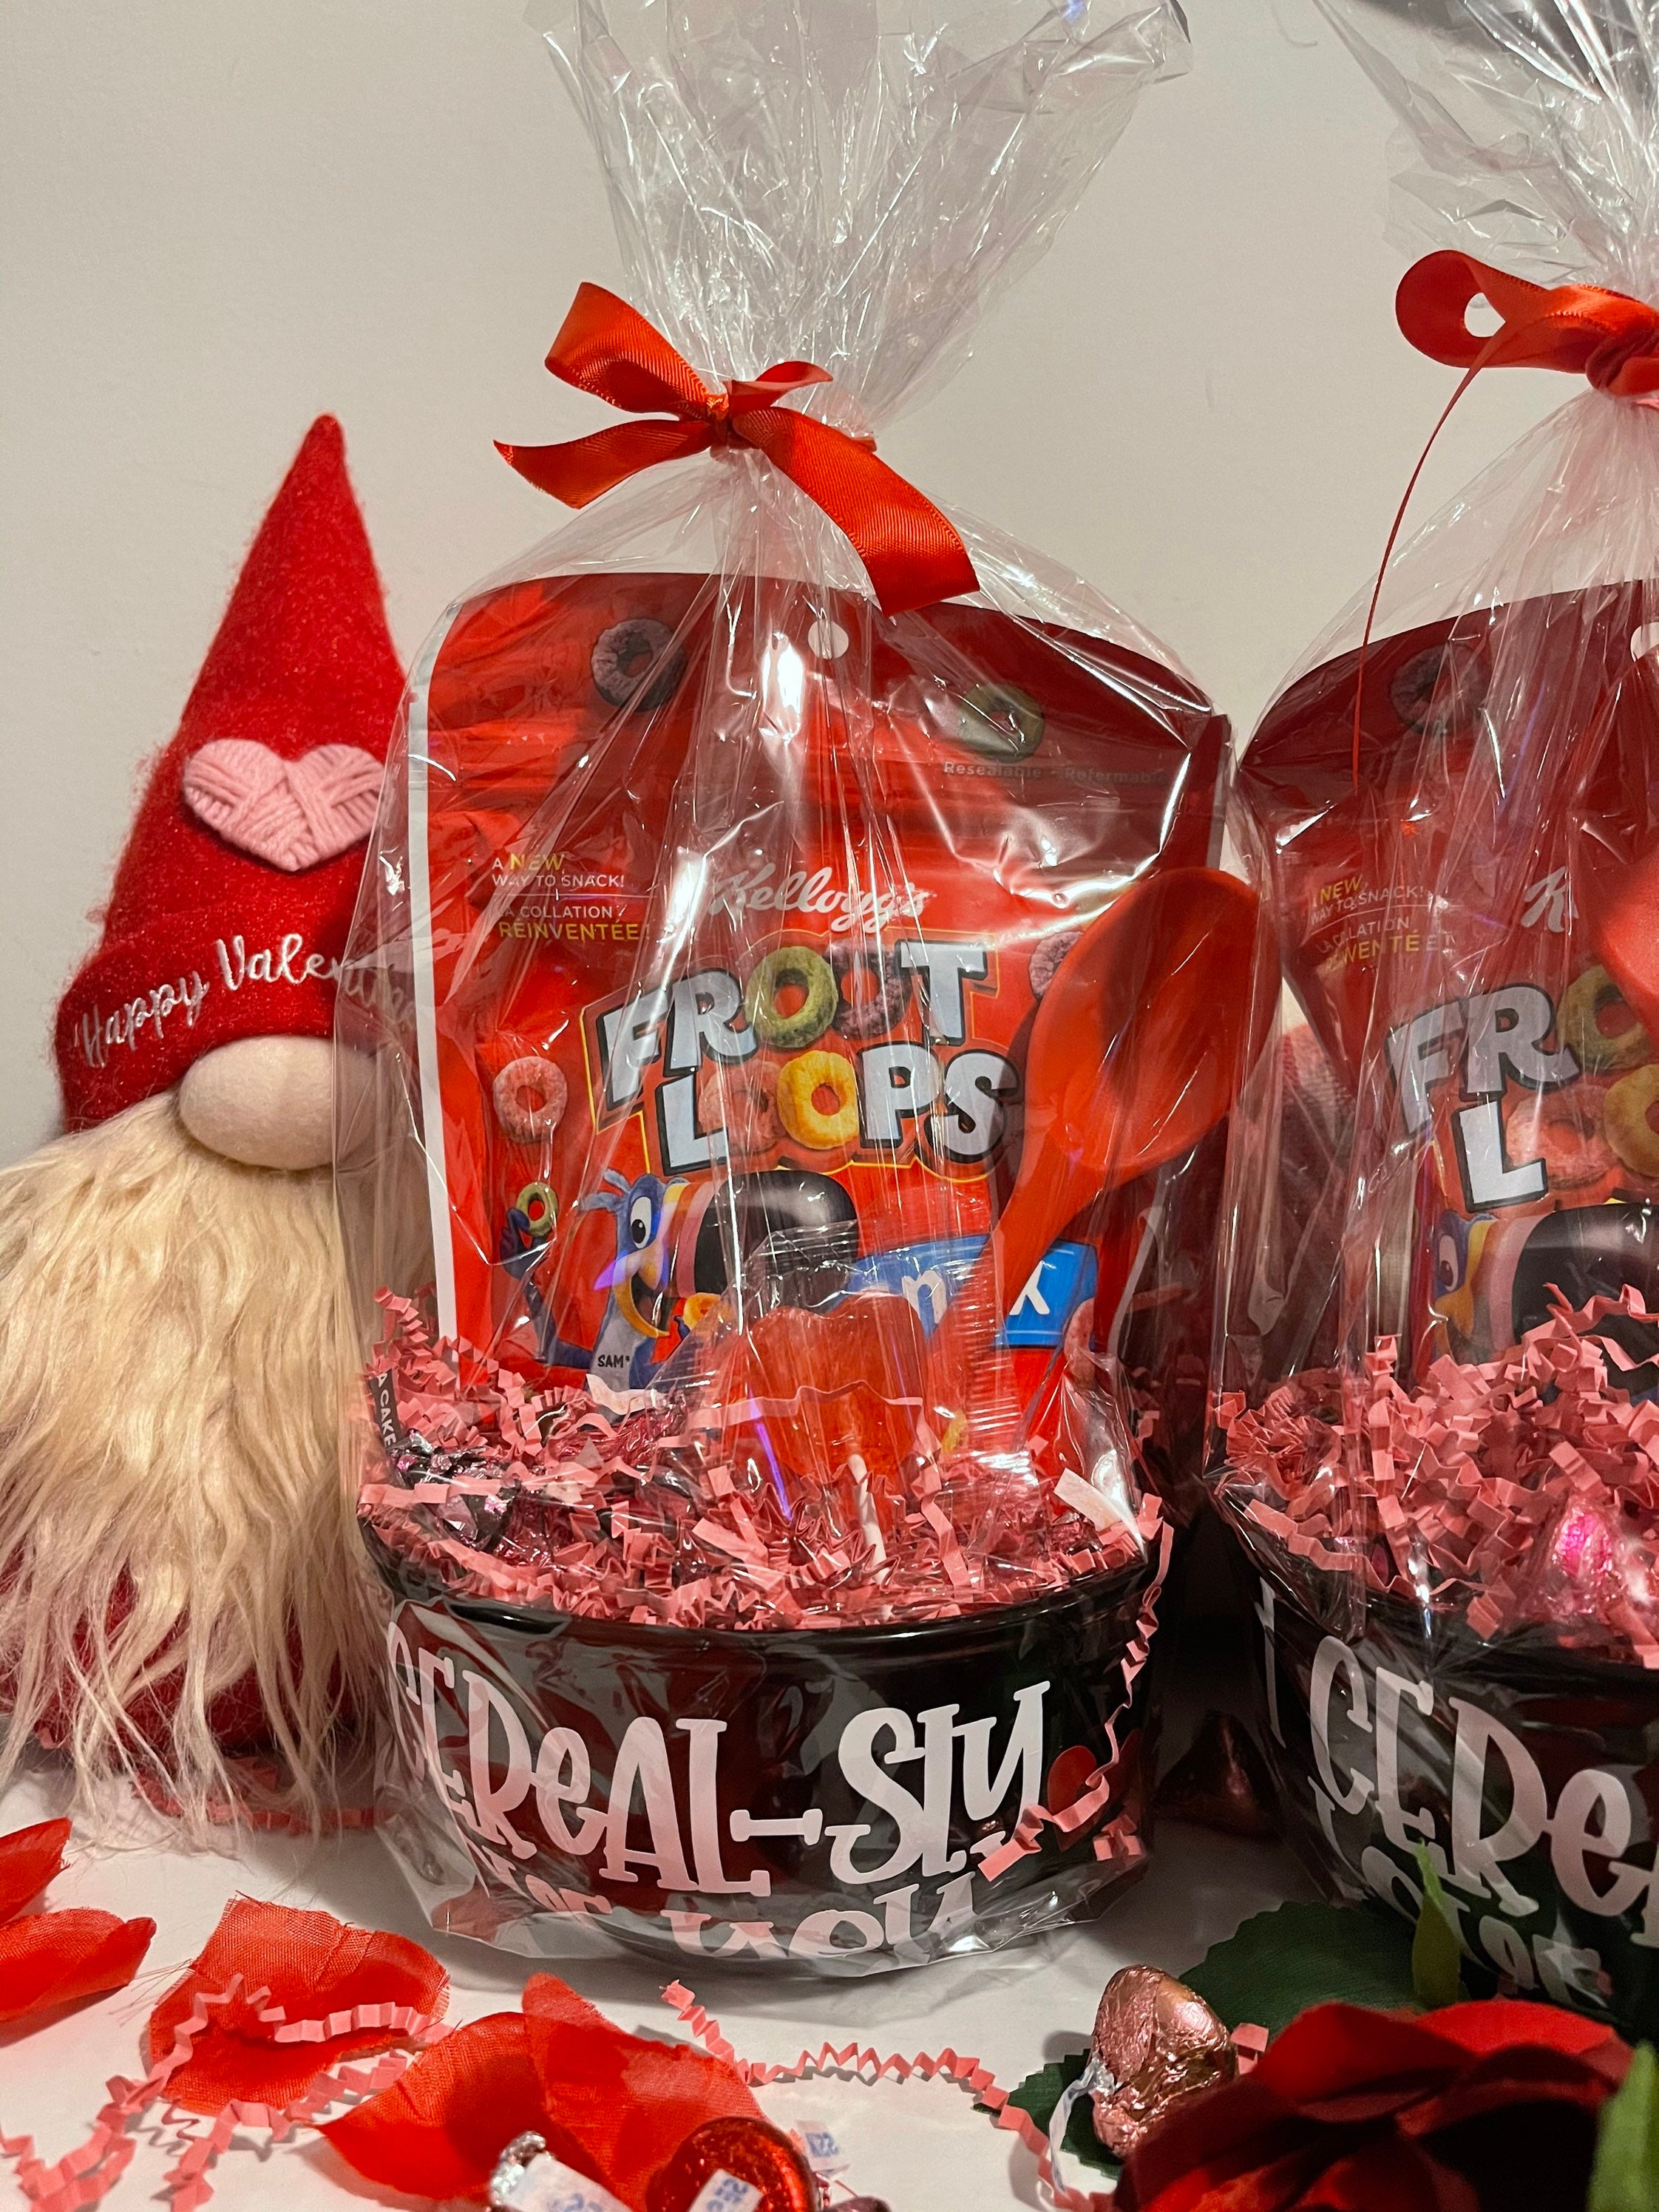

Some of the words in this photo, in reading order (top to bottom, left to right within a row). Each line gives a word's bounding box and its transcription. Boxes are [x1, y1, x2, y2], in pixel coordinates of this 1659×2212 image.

[943, 760, 1042, 778] Resealable
[492, 858, 503, 870] A
[509, 852, 565, 871] NEW
[536, 875, 556, 886] TO
[562, 875, 625, 888] SNACK!
[1320, 874, 1363, 905] NEW
[520, 906, 613, 918] COLLATION
[80, 969, 210, 1070] Happy
[594, 939, 991, 1113] FROOT
[654, 1040, 1022, 1176] LOOPS
[379, 1389, 398, 1448] CAKE
